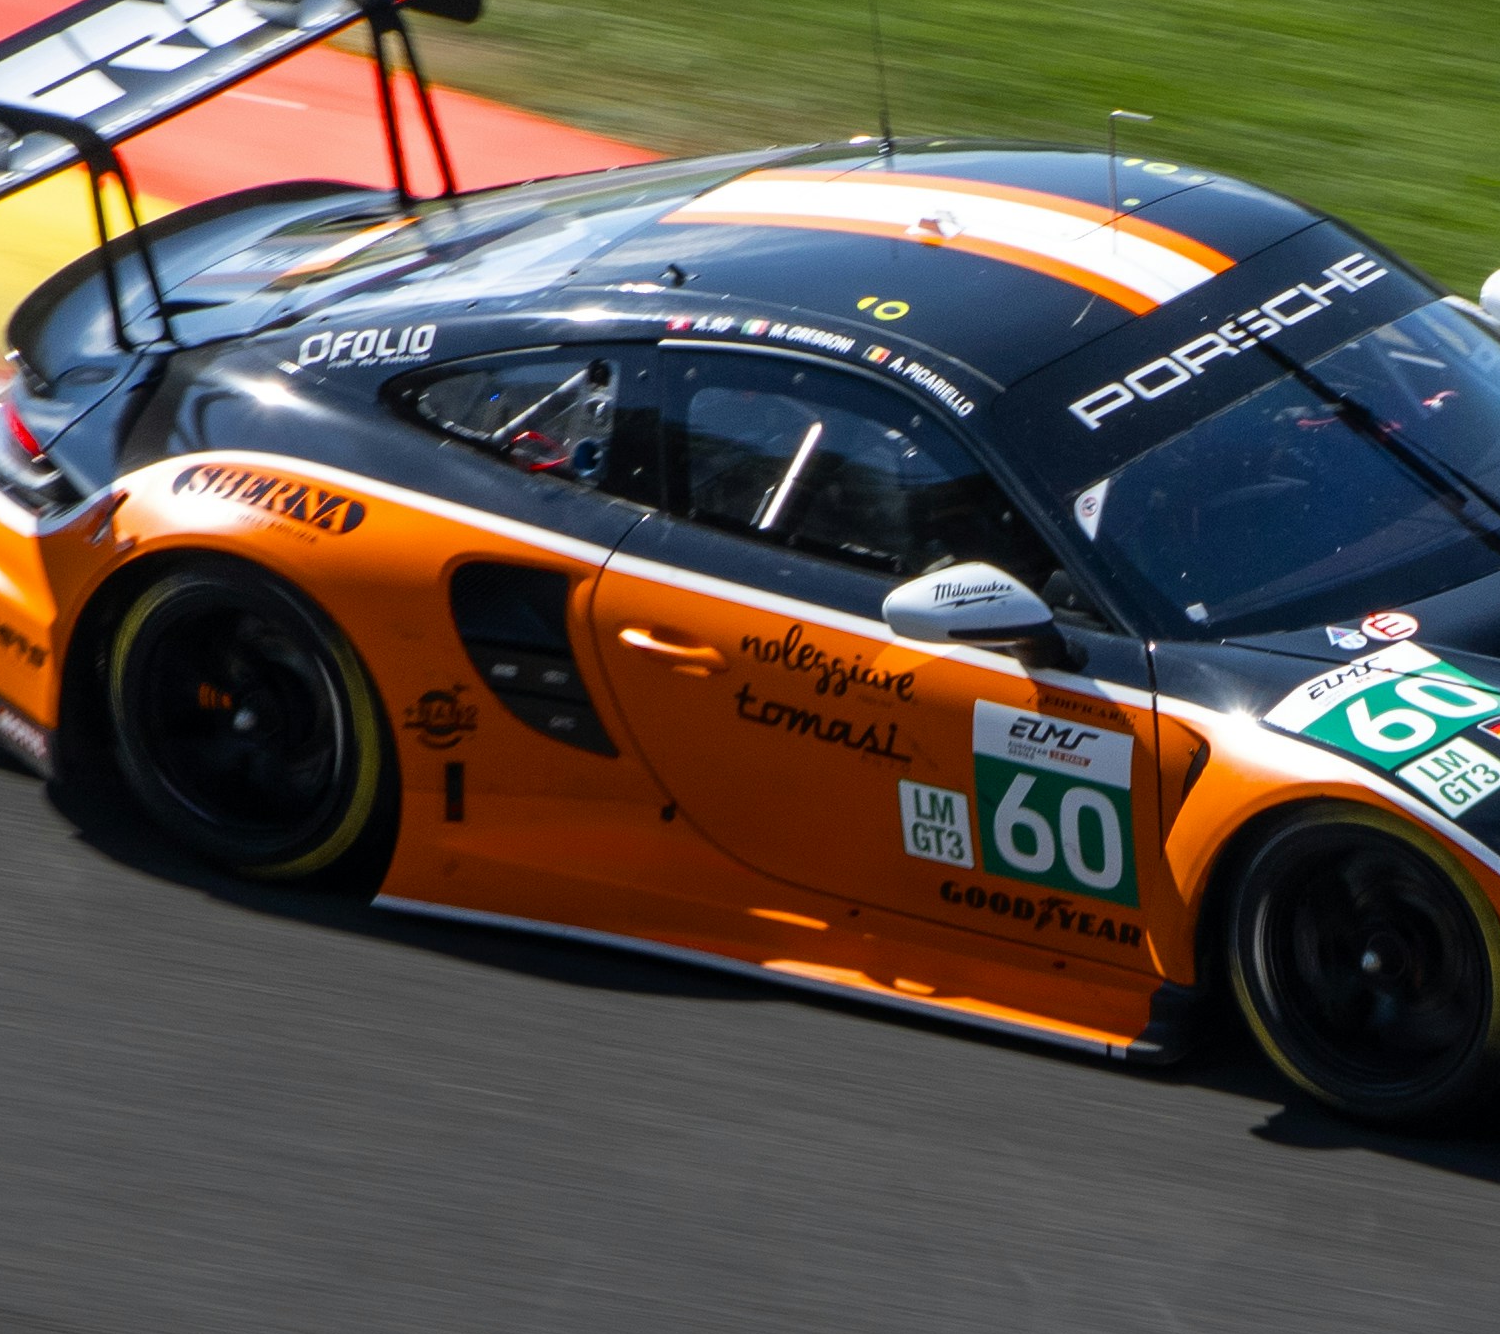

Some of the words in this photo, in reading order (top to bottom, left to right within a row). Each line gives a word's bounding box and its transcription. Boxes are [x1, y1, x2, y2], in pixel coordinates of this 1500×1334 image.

[1068, 252, 1389, 431] PORSCHE
[931, 580, 1014, 602] Milwaukee
[741, 624, 915, 702] noleggiare
[734, 683, 913, 764] tomasi
[1008, 716, 1100, 750] ELMS
[1346, 672, 1499, 753] 60
[1416, 749, 1471, 783] LM
[1438, 763, 1500, 806] GT3
[913, 787, 956, 826] LM
[911, 821, 965, 861] GT3
[993, 772, 1123, 891] 60
